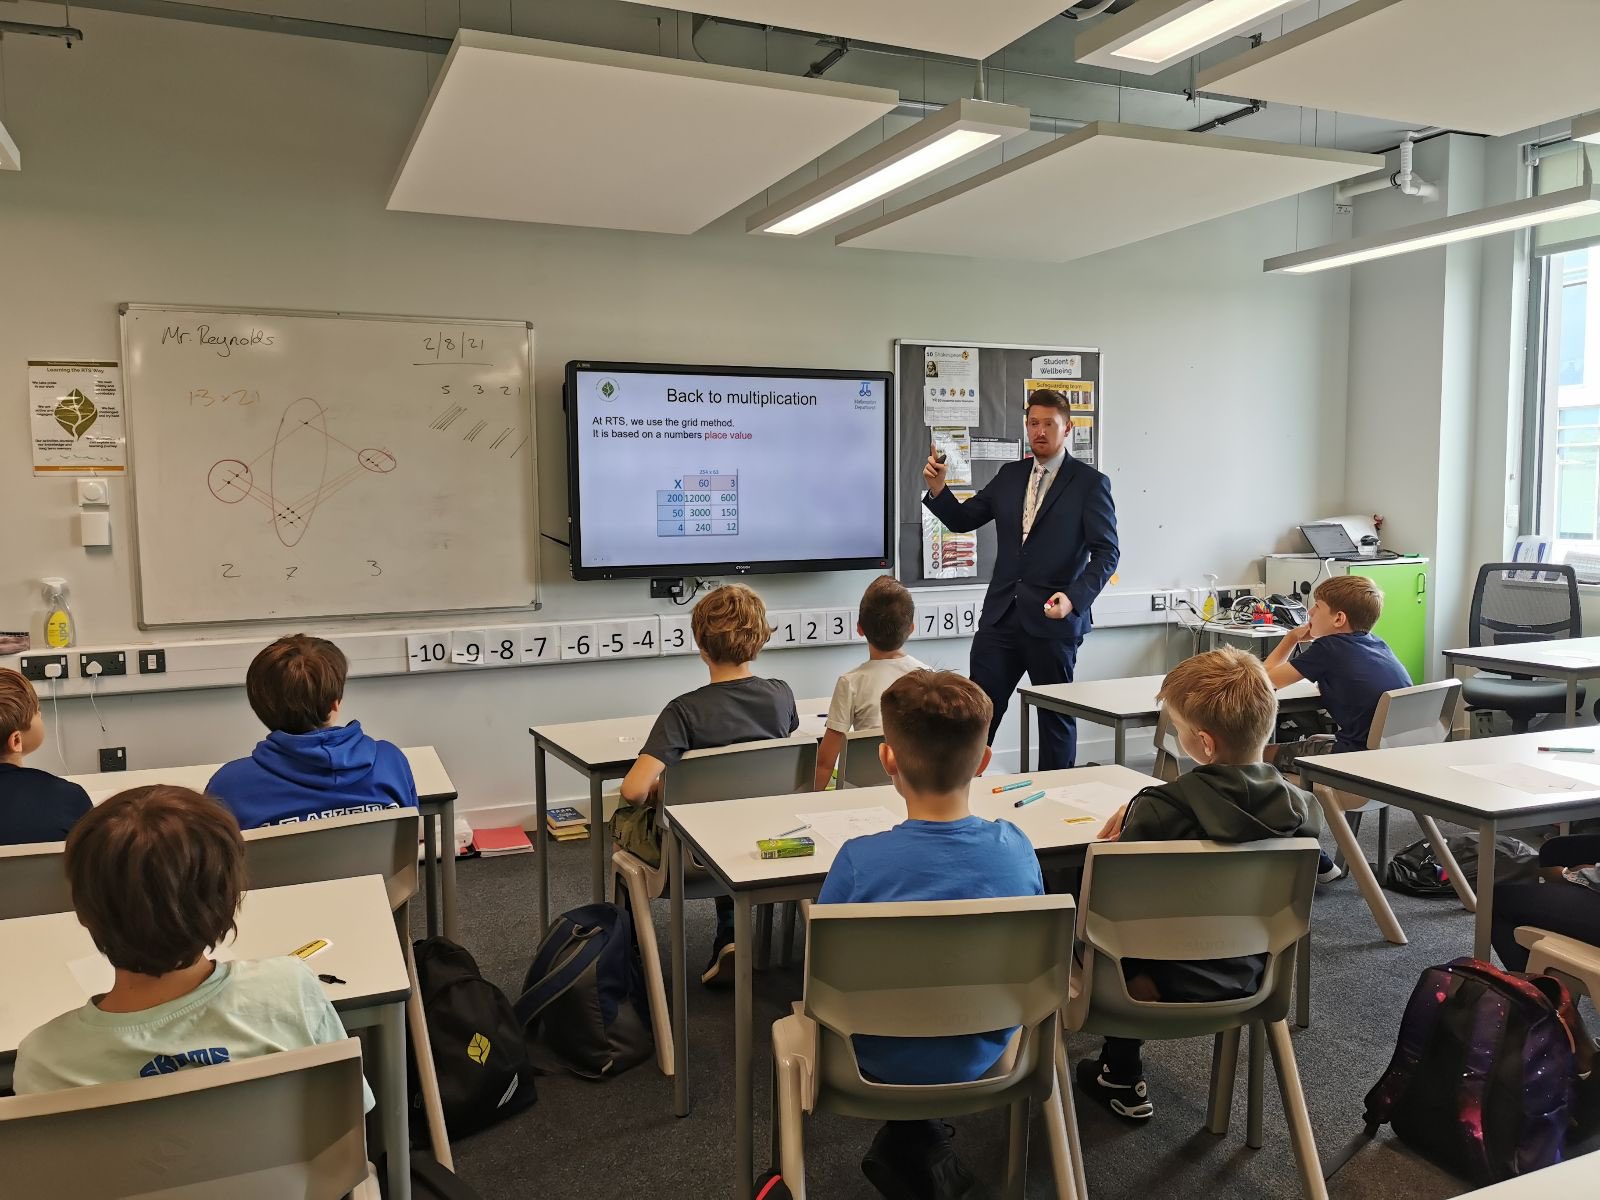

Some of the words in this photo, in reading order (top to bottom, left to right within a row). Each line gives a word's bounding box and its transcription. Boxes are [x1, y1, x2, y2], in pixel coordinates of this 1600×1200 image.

[162, 326, 192, 345] Mr.
[197, 324, 275, 358] Reynolds
[423, 331, 484, 359] 2/8/21
[1040, 367, 1072, 375] Wellbeing
[472, 384, 485, 395] 3
[499, 386, 511, 396] 2
[1036, 382, 1069, 390] Safeguarding
[667, 388, 704, 403] Back
[708, 390, 722, 404] to
[727, 391, 817, 407] multiplication
[592, 416, 603, 425] At
[605, 417, 628, 427] RTS,
[630, 418, 644, 426] we
[646, 418, 663, 427] use
[665, 417, 679, 426] the
[682, 418, 698, 428] grid
[700, 418, 735, 428] method.
[593, 429, 599, 438] It
[601, 429, 609, 438] is
[611, 429, 640, 438] based
[664, 430, 702, 439] numbers
[704, 431, 728, 440] place
[729, 431, 752, 440] value
[698, 479, 709, 488] 60
[730, 479, 736, 488] 3
[667, 494, 683, 503] 200
[685, 494, 711, 503] 12000
[720, 493, 736, 502] 600
[672, 509, 683, 518] 50
[690, 508, 711, 517] 3000
[721, 508, 737, 517] 150
[678, 524, 683, 532] 4
[695, 523, 711, 532] 240
[727, 522, 736, 531] 12
[221, 563, 241, 578] 2
[286, 566, 298, 580] 7
[367, 560, 382, 576] 3
[924, 615, 935, 633] 7
[943, 613, 954, 630] 8
[963, 610, 974, 628] 9
[785, 623, 796, 642] 1
[806, 622, 817, 640] 2
[833, 617, 844, 635] 3
[410, 643, 446, 662] -10
[456, 643, 480, 662] -9
[490, 639, 514, 660] -8
[525, 637, 547, 657] -7
[567, 635, 590, 655] -6
[602, 633, 624, 653] -5
[632, 630, 655, 650] -4
[664, 628, 685, 648] -3
